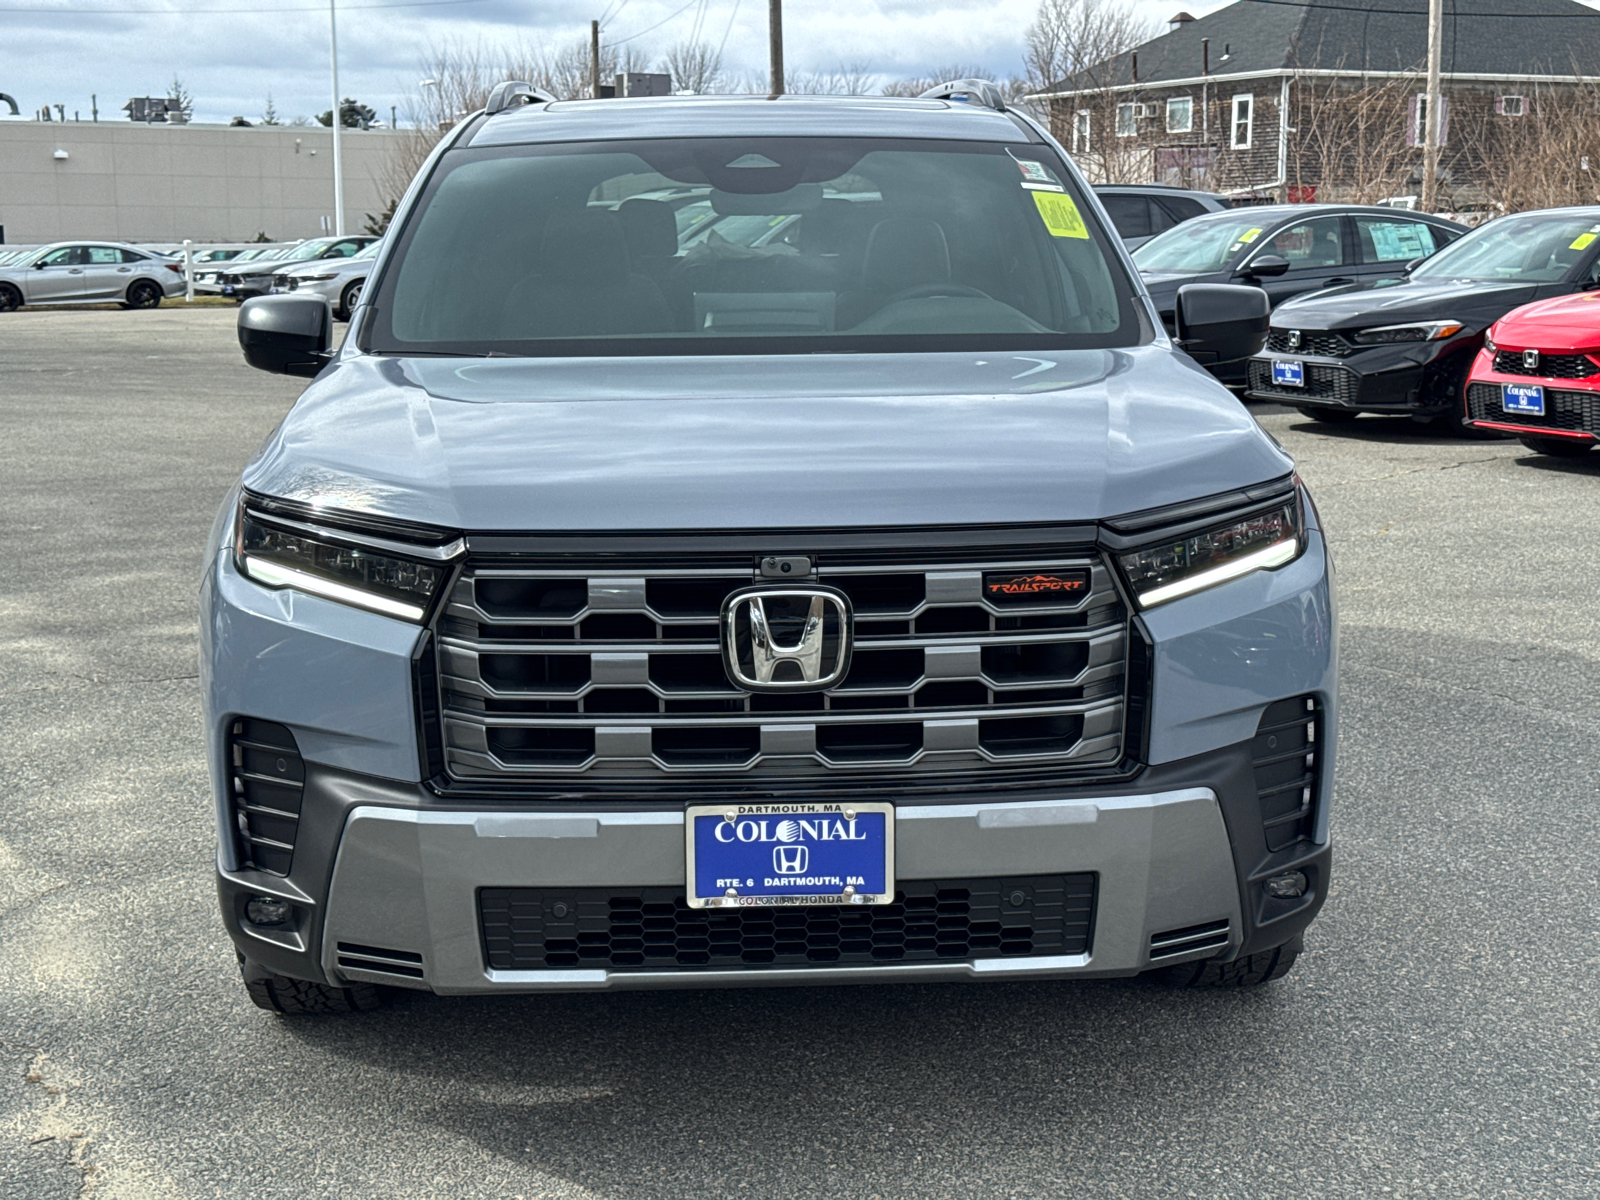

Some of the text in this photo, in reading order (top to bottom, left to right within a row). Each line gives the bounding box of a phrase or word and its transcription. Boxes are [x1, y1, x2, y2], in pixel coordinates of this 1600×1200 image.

[989, 581, 1083, 593] TRAILSPORT
[823, 804, 842, 812] MA
[714, 819, 866, 843] COLONIAL
[716, 876, 865, 887] RTE. 6 DARTMOUTH, MA
[801, 895, 843, 904] HONDA
